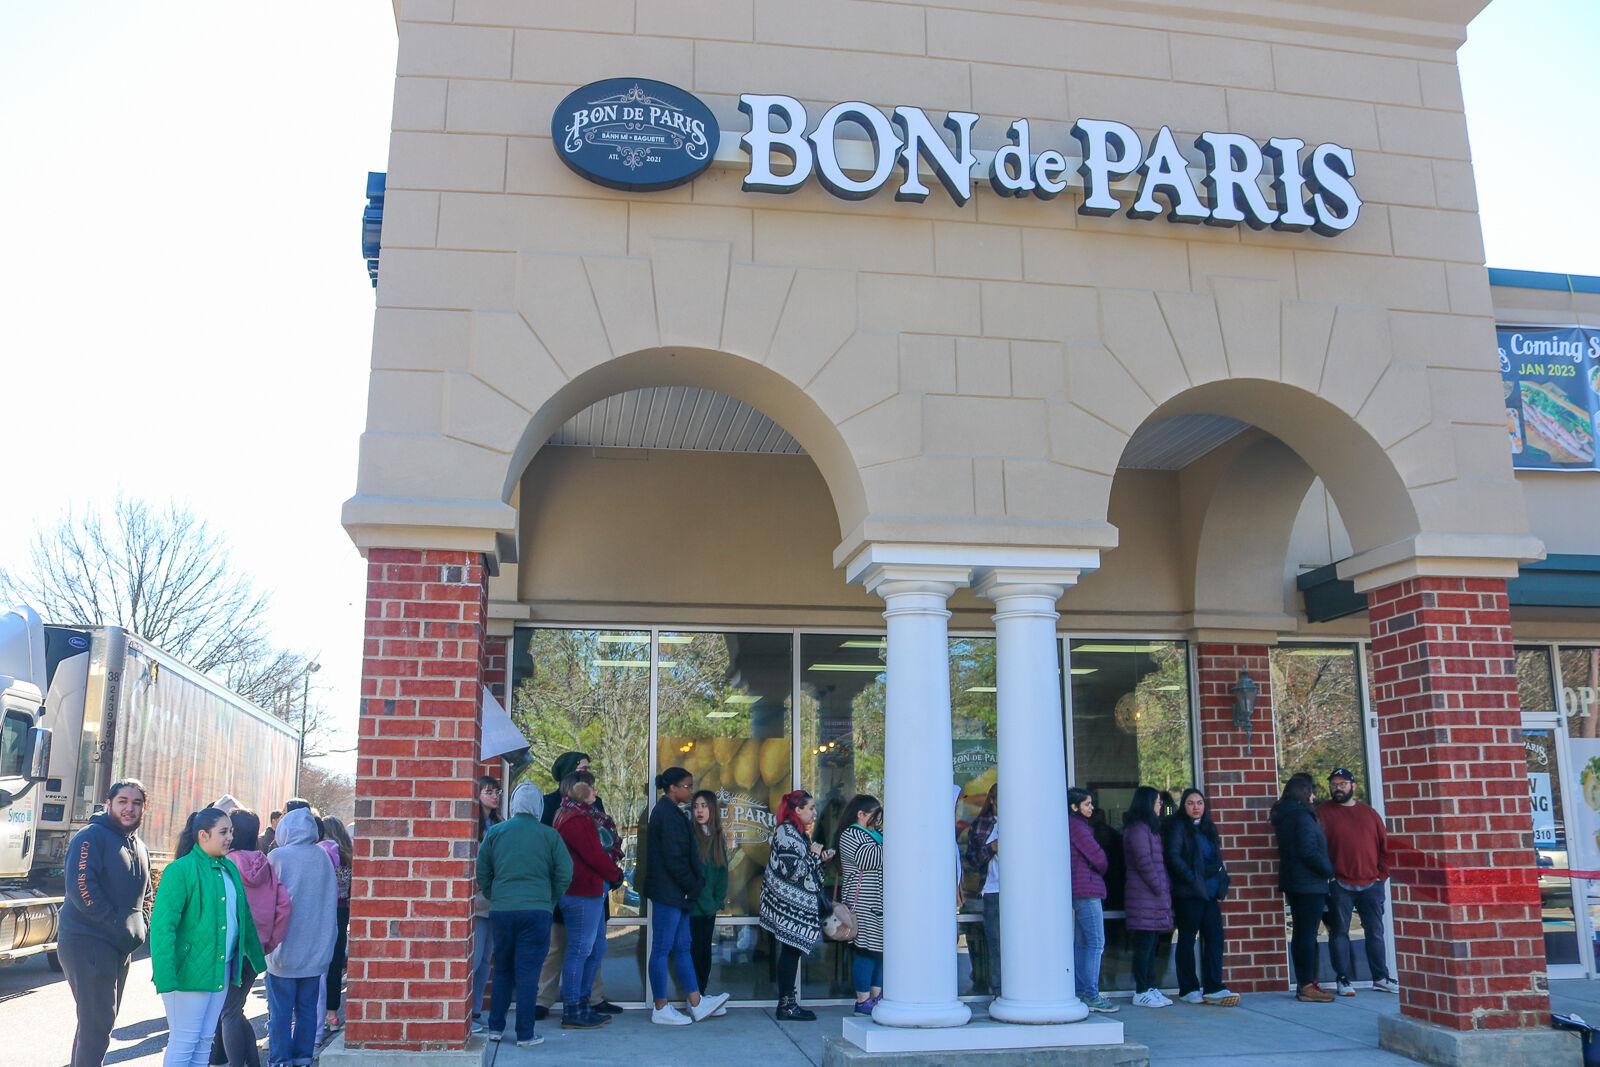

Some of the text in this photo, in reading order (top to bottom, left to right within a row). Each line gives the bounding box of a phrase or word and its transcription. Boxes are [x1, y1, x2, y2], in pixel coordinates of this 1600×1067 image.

[564, 105, 708, 157] BON DE PARIS
[633, 135, 665, 143] BAGUETTE
[608, 153, 662, 163] ATL 2021
[738, 93, 1363, 237] BON de PARIS
[1511, 333, 1584, 363] Coming
[1587, 336, 1600, 359] S
[1518, 363, 1577, 377] JAN 2023
[1563, 686, 1600, 717] OP
[984, 753, 998, 763] PA
[1533, 829, 1552, 840] 310
[79, 841, 91, 871] CEDAR
